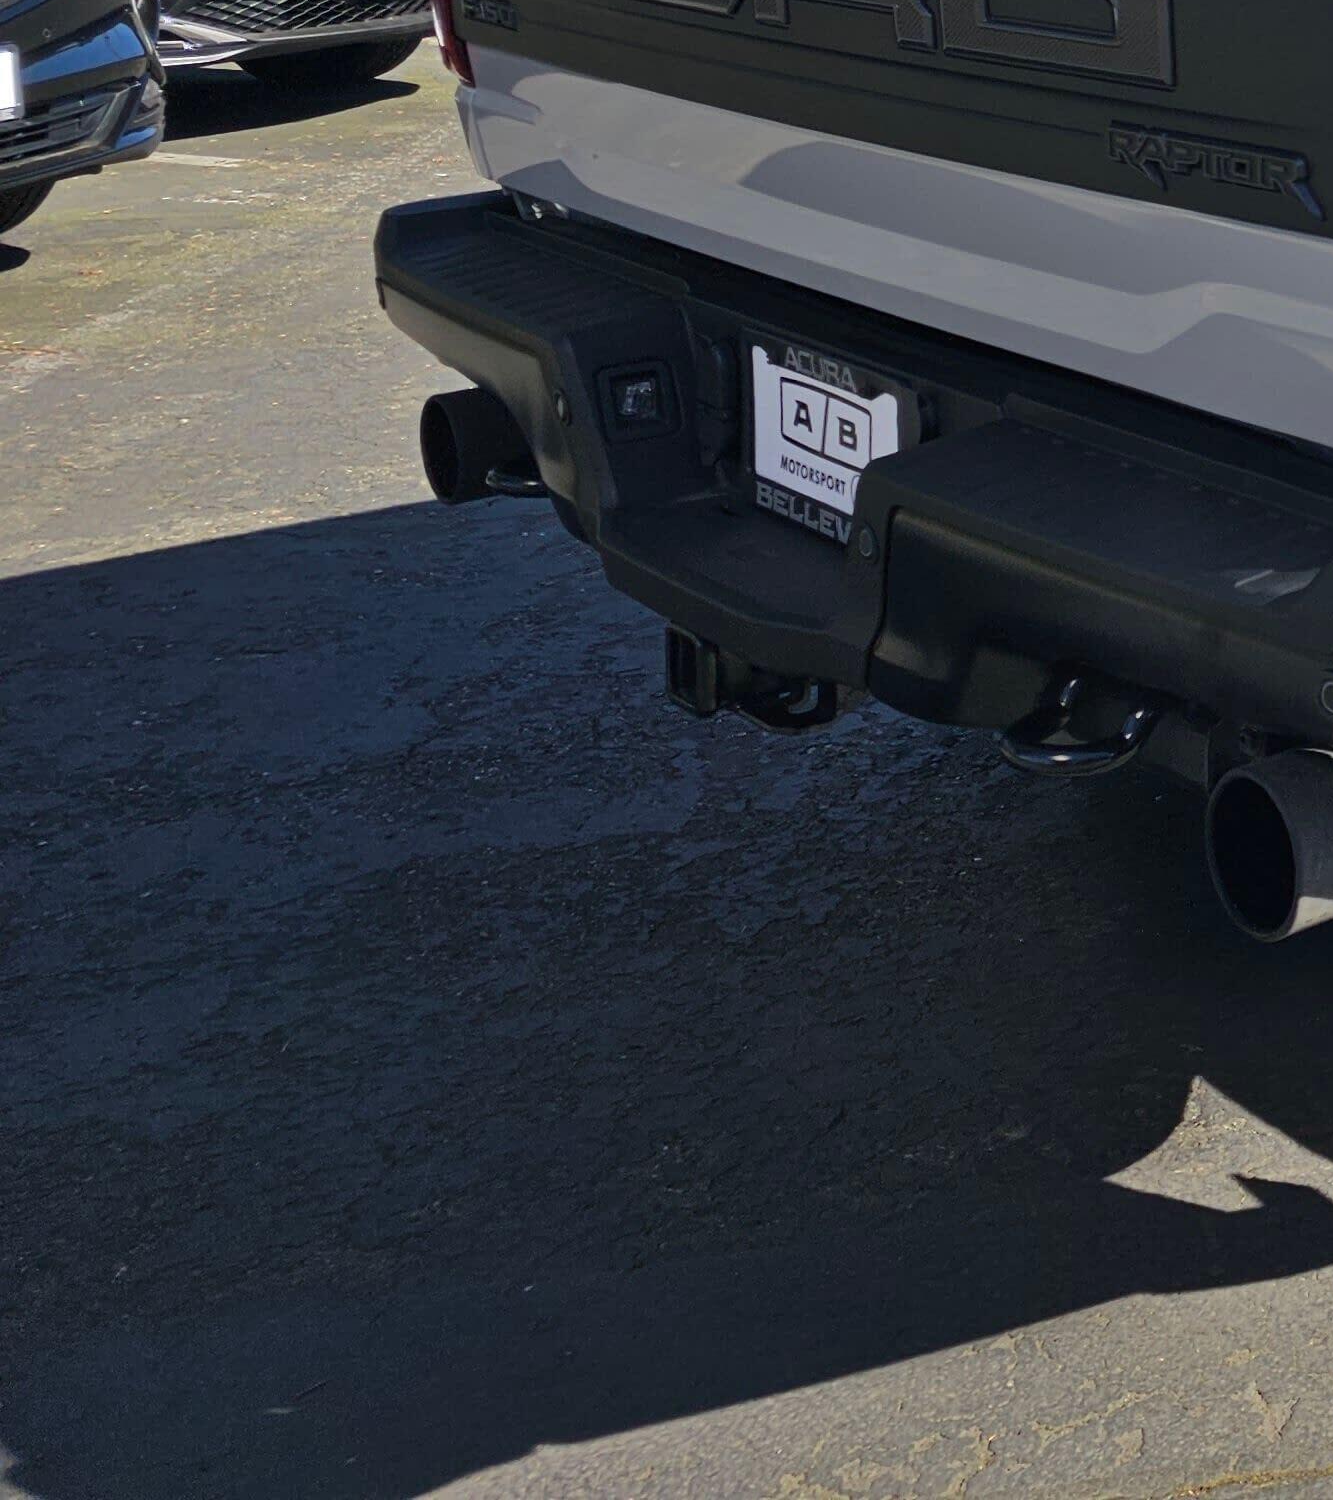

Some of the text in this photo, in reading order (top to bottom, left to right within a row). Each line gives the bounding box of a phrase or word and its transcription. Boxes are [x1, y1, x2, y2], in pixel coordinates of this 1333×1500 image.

[1105, 120, 1326, 222] RAPTOR
[784, 346, 858, 393] ACURA
[793, 400, 858, 452] A B
[780, 453, 846, 496] MOTORSPORT
